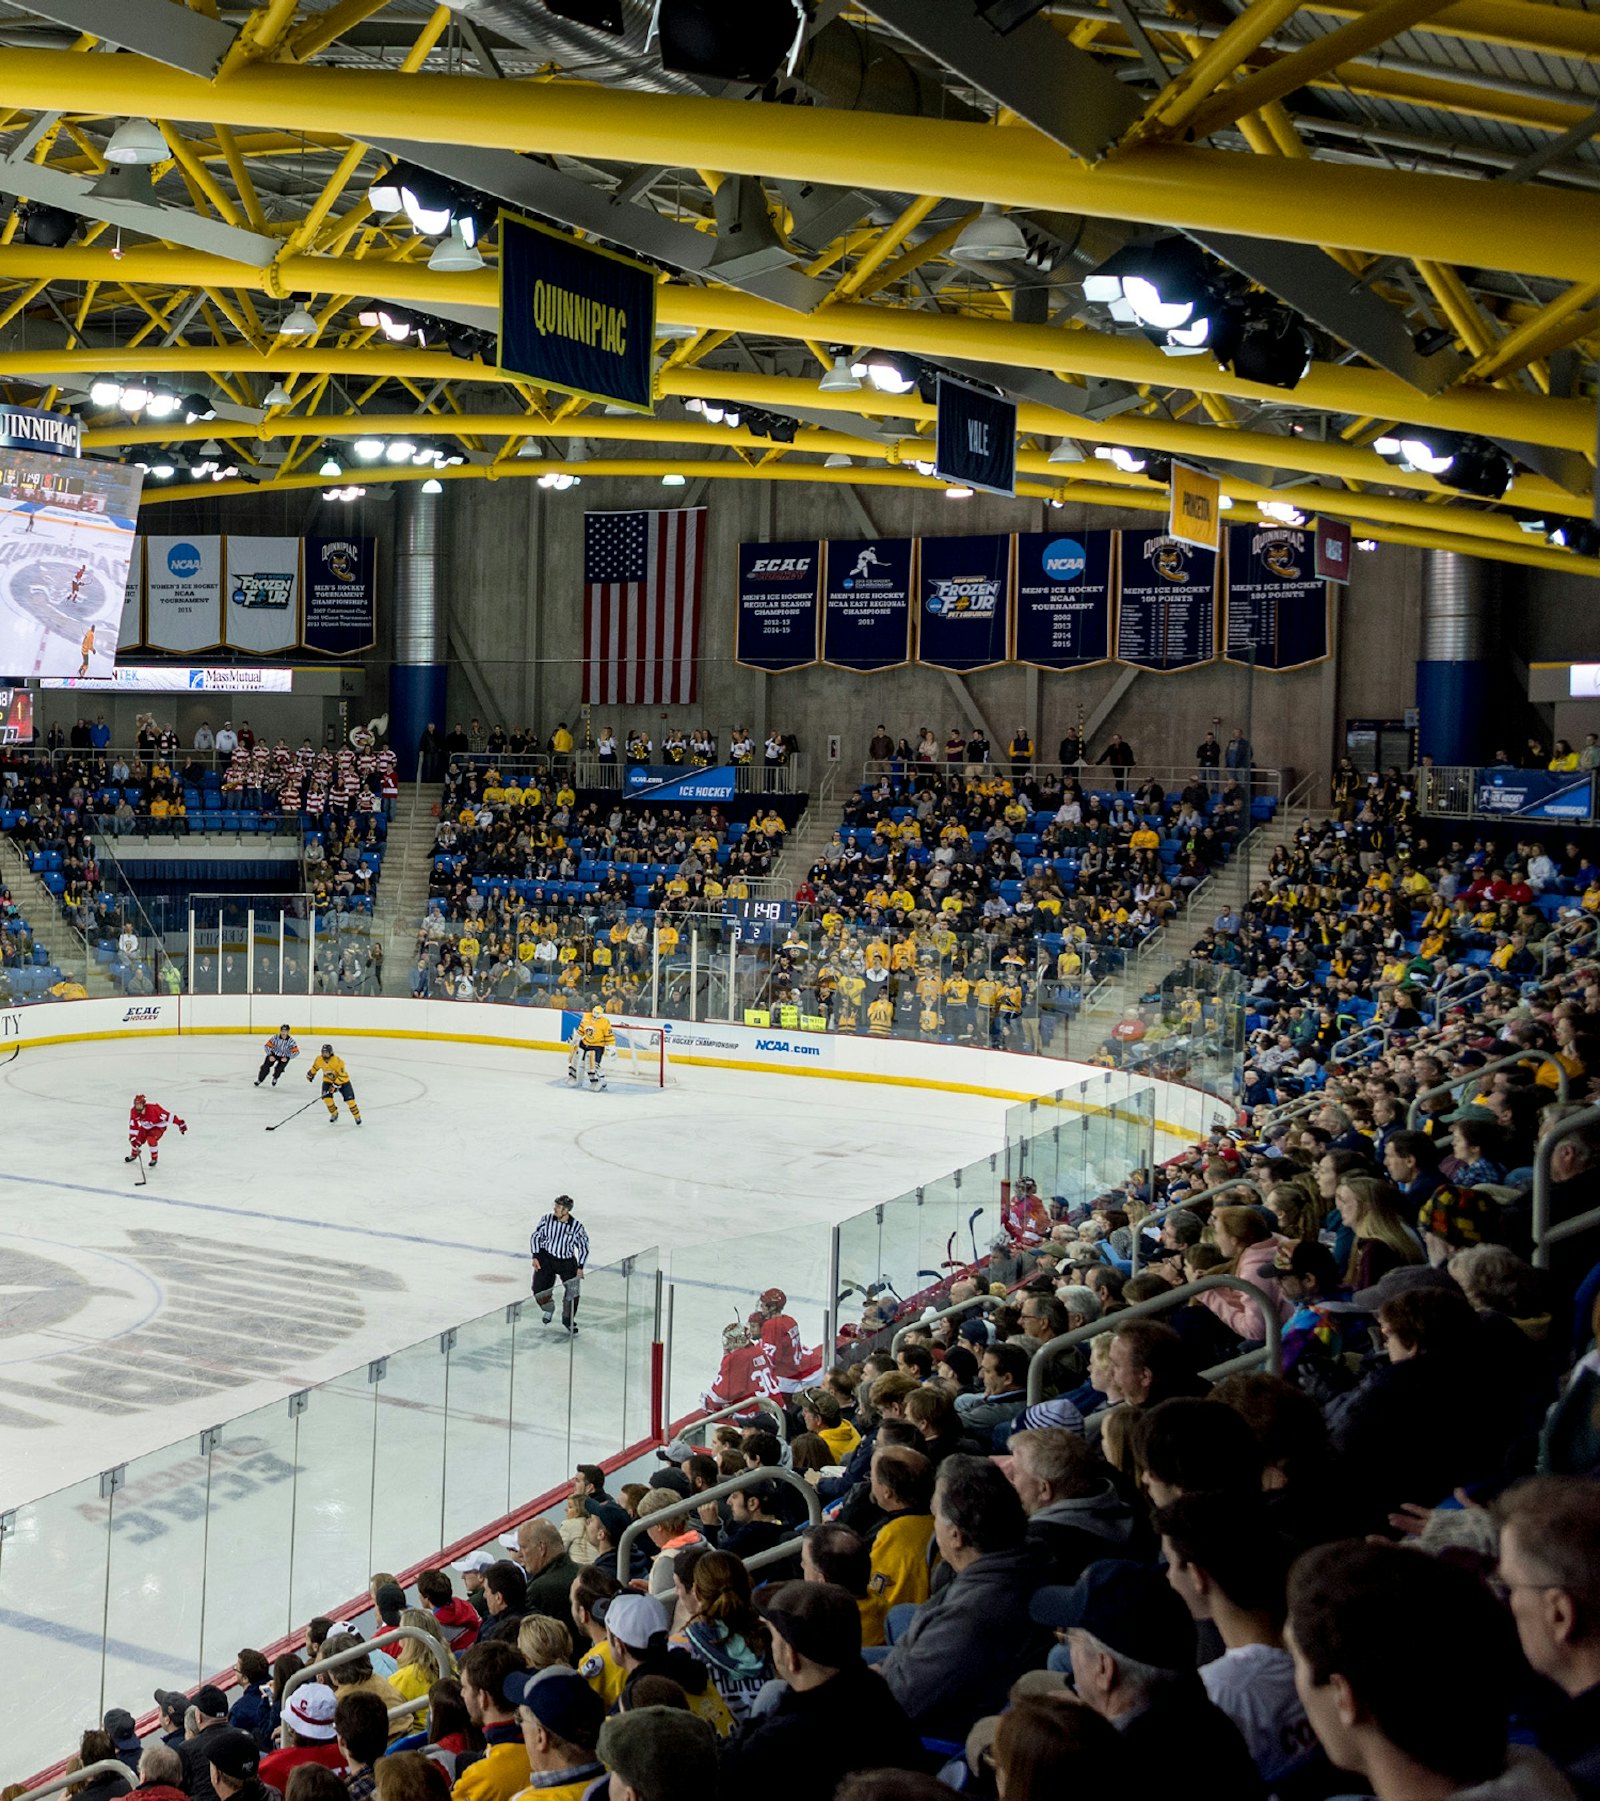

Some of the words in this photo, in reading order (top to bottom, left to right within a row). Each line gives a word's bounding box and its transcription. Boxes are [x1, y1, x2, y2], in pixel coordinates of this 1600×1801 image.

[533, 279, 627, 356] QUINNIPIAC
[968, 418, 989, 456] YALE
[1252, 530, 1305, 555] QUINNIPIAC
[171, 560, 200, 569] NCAA
[752, 558, 811, 572] ECAC
[1046, 558, 1084, 570] NCAA
[240, 576, 291, 591] FROZEN
[934, 581, 998, 596] FROZEN
[1282, 581, 1323, 590] HOCKEY
[206, 670, 262, 682] MassMutual
[17, 702, 22, 720] 1
[679, 786, 694, 797] ICE
[695, 786, 732, 798] HOCKEY
[744, 902, 780, 920] 11:48
[753, 928, 760, 938] 2
[126, 1006, 161, 1015] ECAC
[672, 1036, 694, 1046] HOCKEY
[695, 1039, 739, 1050] CHAMPIONSHIP
[755, 1039, 820, 1056] NCAA.com
[751, 1367, 780, 1398] 30
[300, 1699, 308, 1711] C
